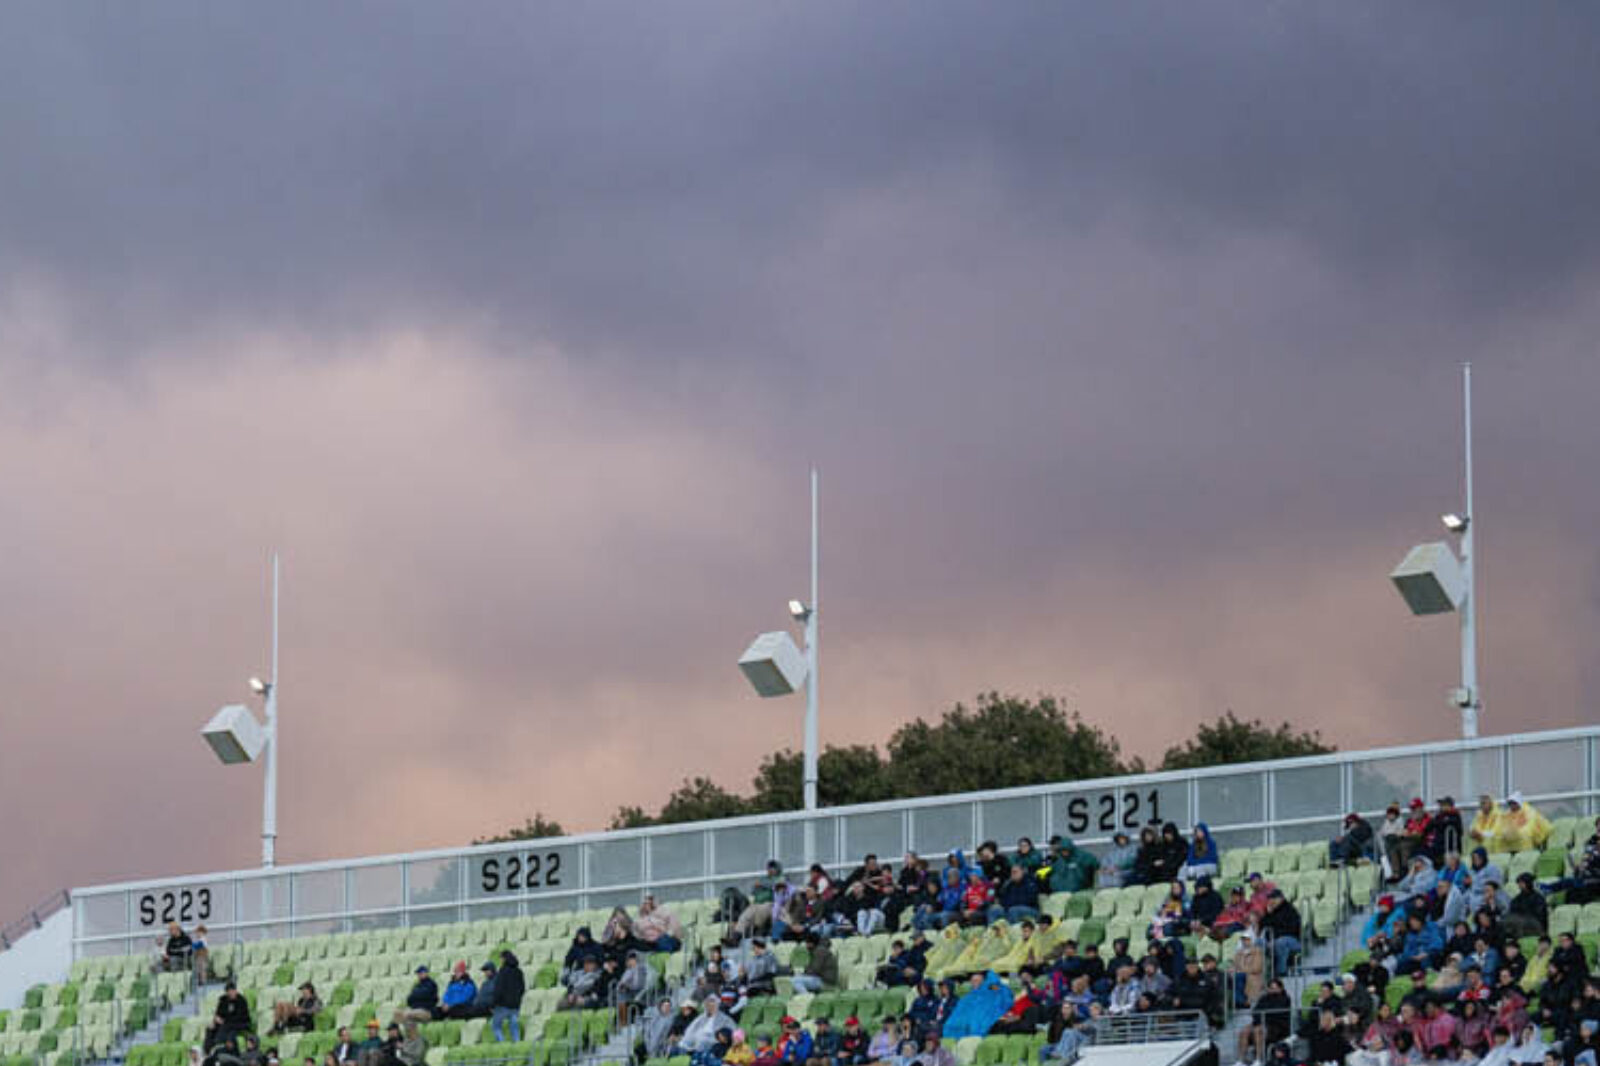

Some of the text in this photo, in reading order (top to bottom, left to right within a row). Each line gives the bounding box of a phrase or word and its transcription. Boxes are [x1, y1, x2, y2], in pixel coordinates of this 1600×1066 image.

[1068, 789, 1163, 834] S221
[482, 853, 560, 892] S222
[140, 888, 210, 926] S223
